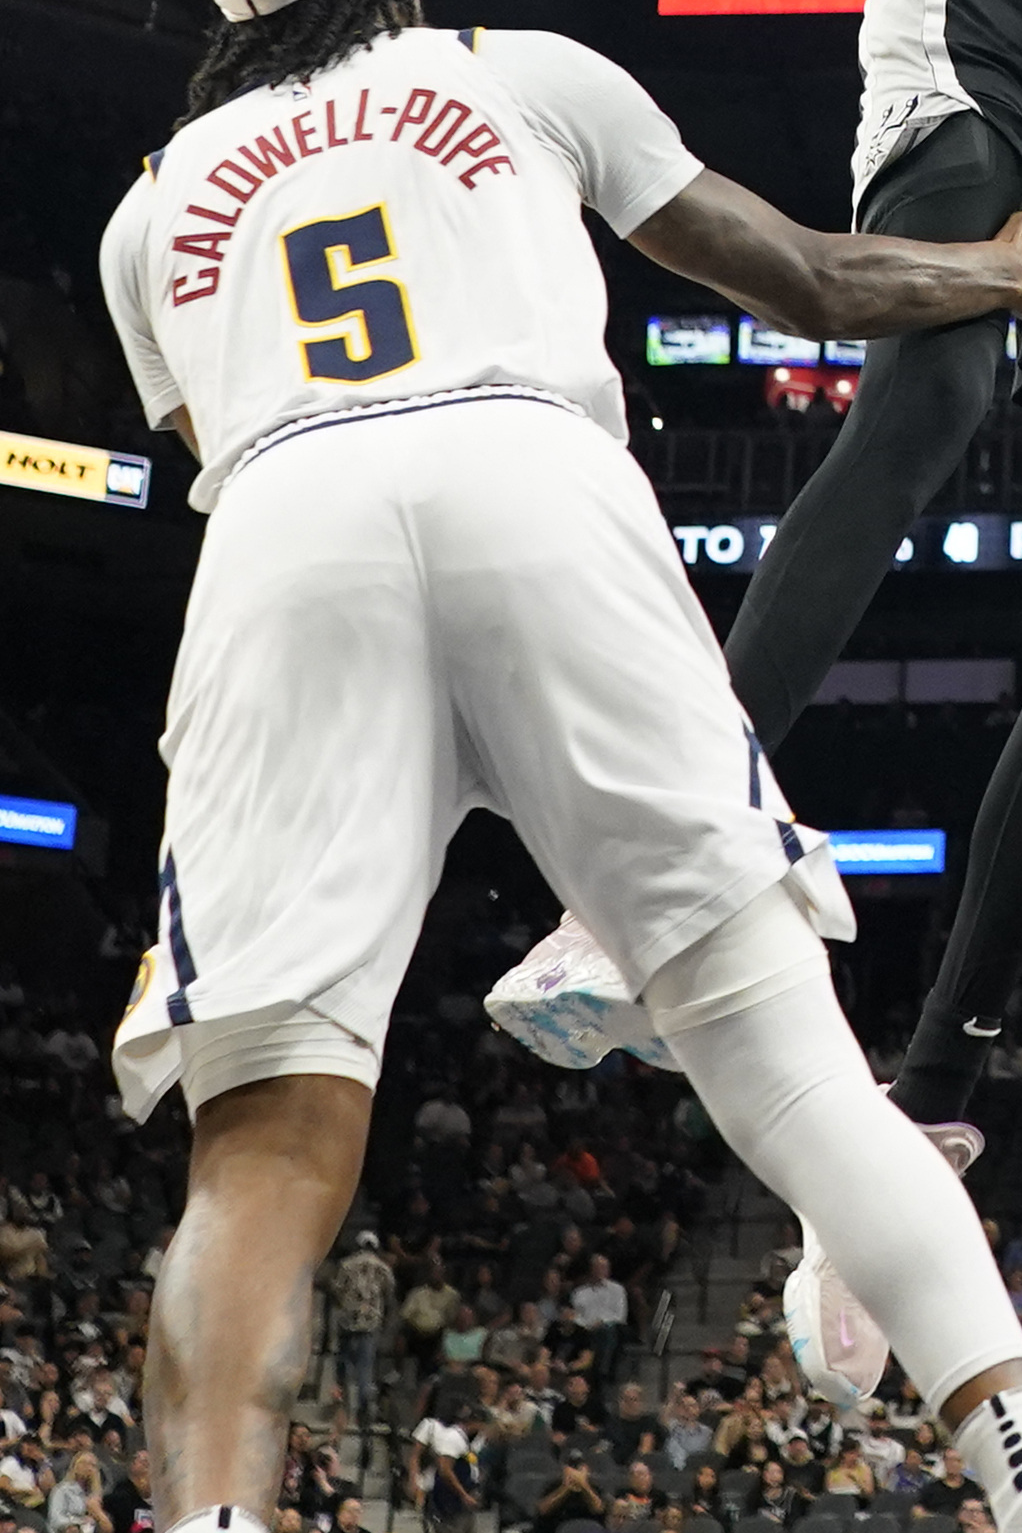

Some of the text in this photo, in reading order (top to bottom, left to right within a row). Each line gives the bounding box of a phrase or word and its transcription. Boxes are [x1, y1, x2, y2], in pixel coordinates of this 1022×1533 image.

[171, 87, 518, 308] CALDWELL-POPE
[279, 201, 422, 386] 5
[6, 453, 86, 478] HOLT
[673, 524, 745, 565] TO
